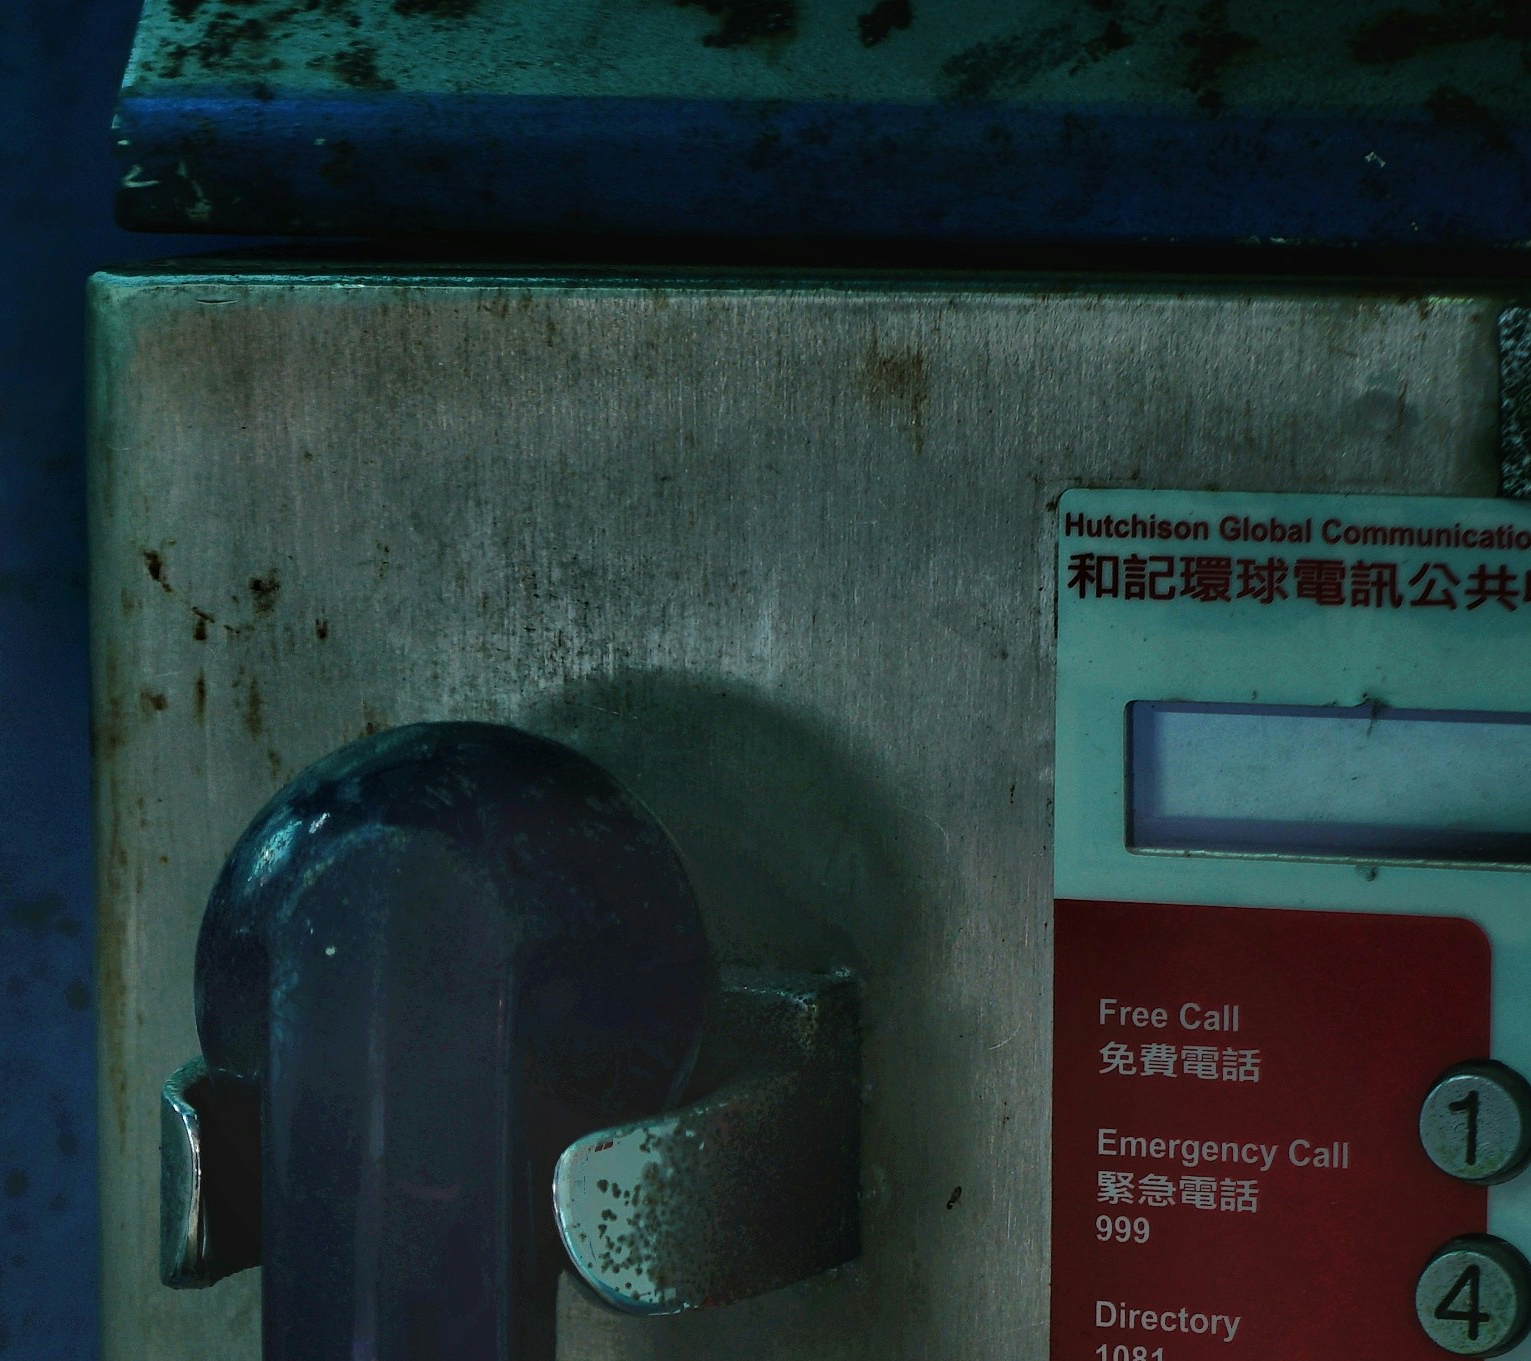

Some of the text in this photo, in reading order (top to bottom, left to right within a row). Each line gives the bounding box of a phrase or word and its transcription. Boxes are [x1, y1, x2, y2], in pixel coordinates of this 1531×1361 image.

[1065, 512, 1209, 541] Hutchison
[1220, 515, 1311, 544] Global
[1099, 999, 1240, 1032] Free Call
[1099, 1041, 1261, 1083] 免費電話
[1448, 1089, 1478, 1166] 1
[1098, 1128, 1349, 1172] Emergency Call
[1097, 1170, 1259, 1213] 緊急電話
[1096, 1215, 1151, 1243] 999
[1096, 1301, 1240, 1342] Directory
[1434, 1264, 1490, 1341] 4
